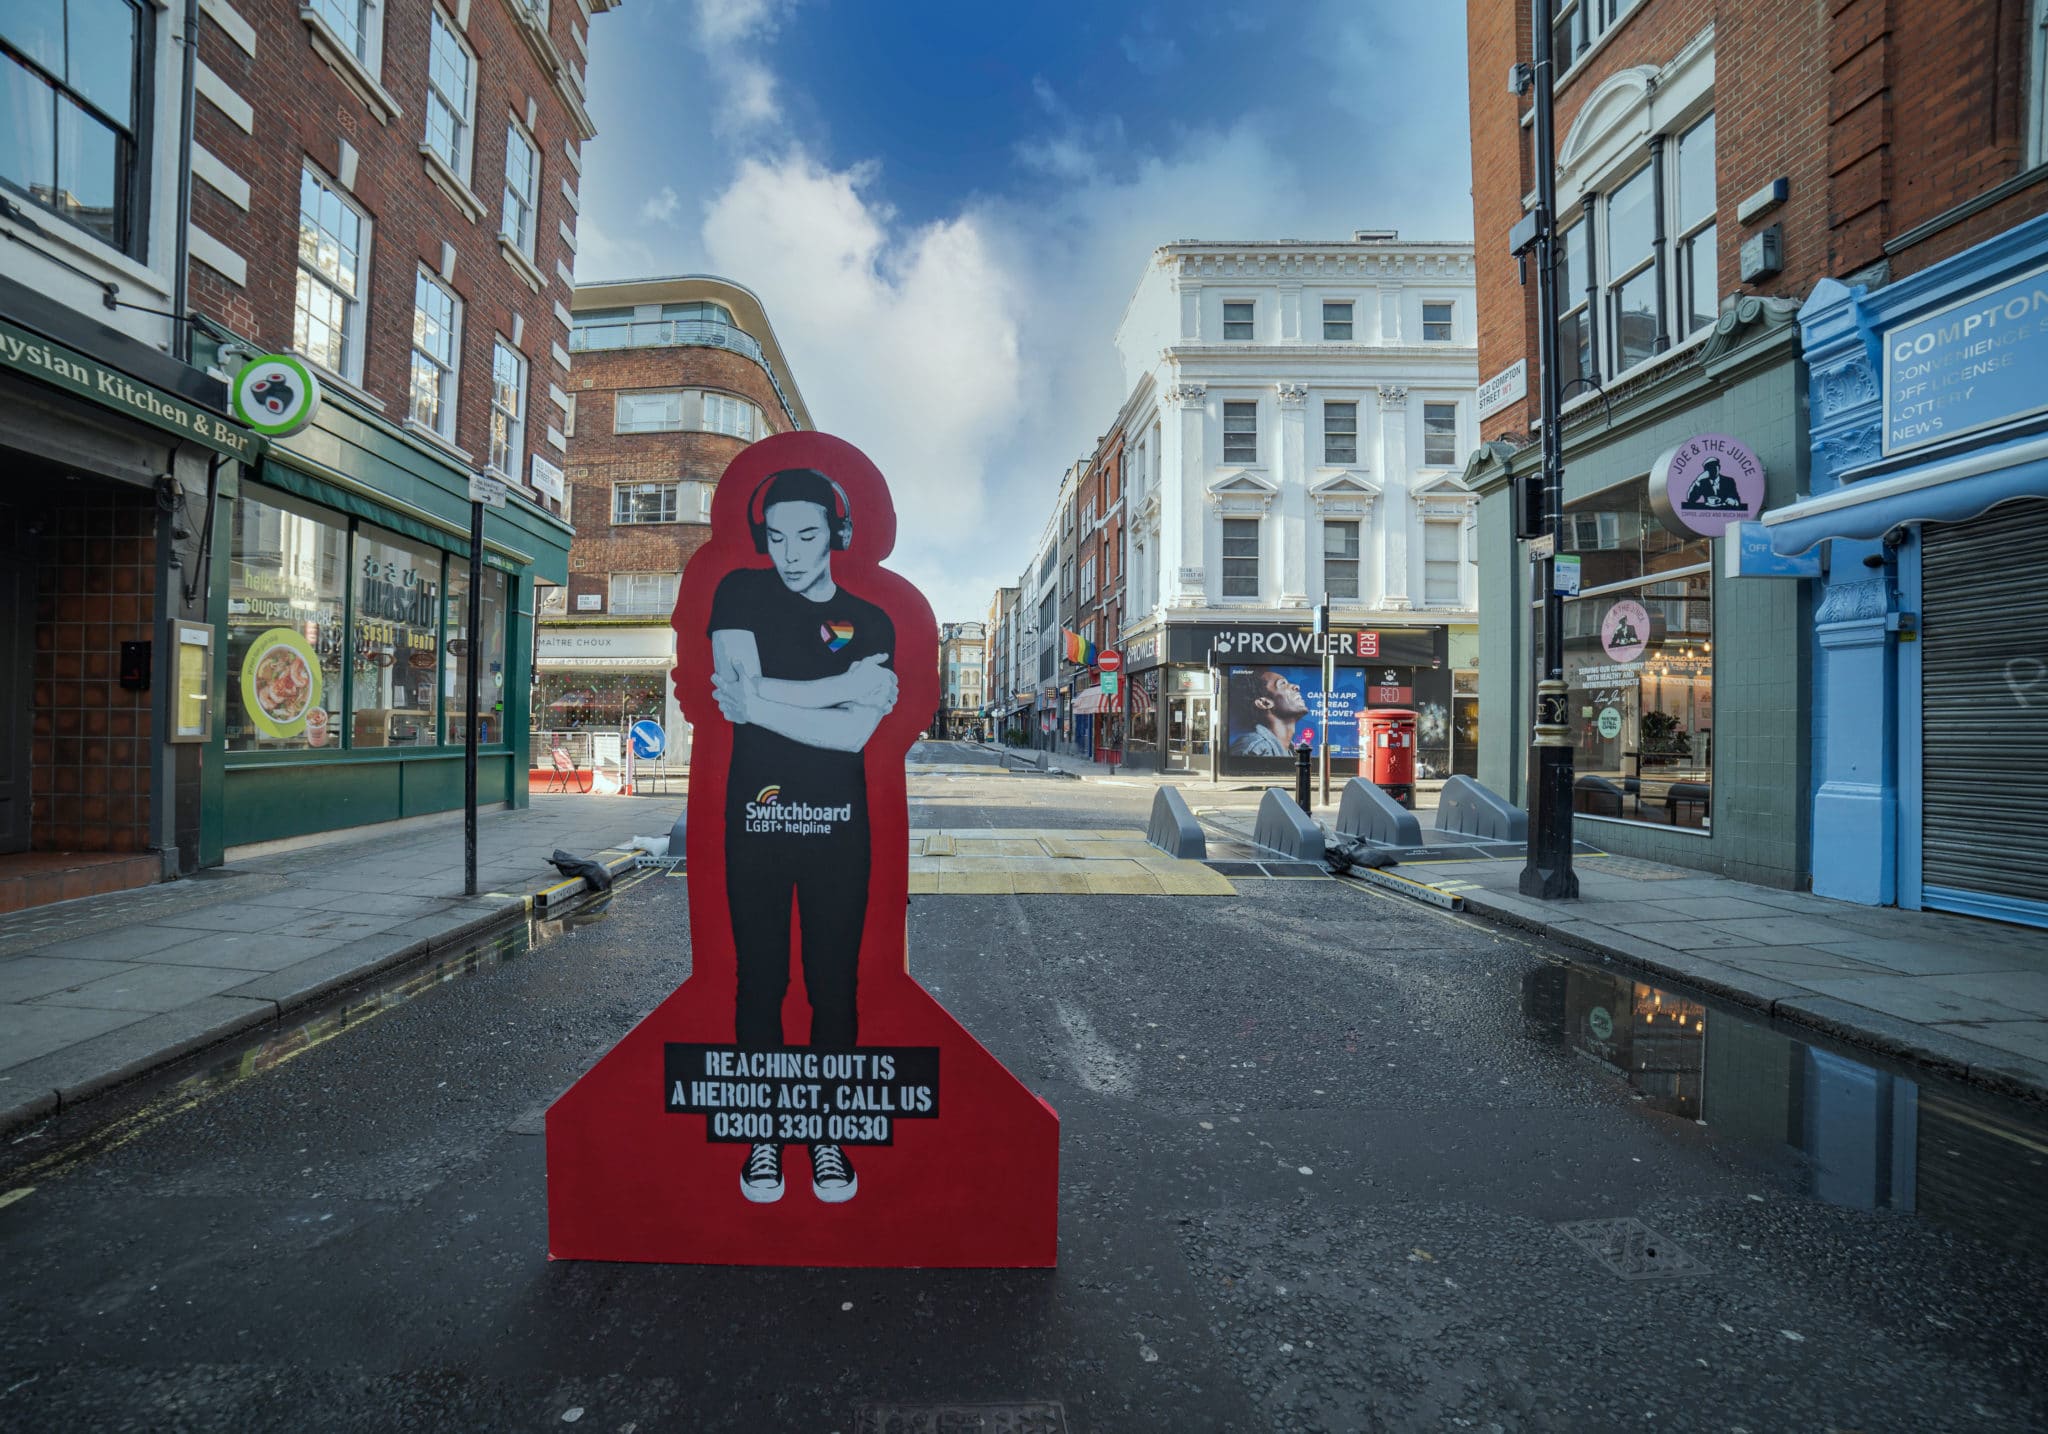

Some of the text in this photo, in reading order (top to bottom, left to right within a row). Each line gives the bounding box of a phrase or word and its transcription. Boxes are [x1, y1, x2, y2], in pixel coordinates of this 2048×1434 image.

[1479, 365, 1521, 399] OLD COMPTON
[1895, 352, 2014, 402] OFF LICENSE
[97, 369, 188, 427] Kitchen
[193, 413, 209, 436] &
[214, 422, 249, 451] Bar
[1479, 389, 1500, 410] STREET
[1893, 386, 1975, 423] LOTTERY
[1673, 440, 1756, 477] JOE & THE JUICE
[1749, 543, 1768, 553] OFF
[244, 597, 280, 620] soups
[363, 624, 393, 645] sushi
[539, 637, 612, 647] MAÎTRE CHOUX
[1237, 632, 1354, 655] PROWLER
[1360, 633, 1376, 655] RED
[1622, 671, 1635, 679] AND
[1381, 687, 1400, 703] RED
[745, 801, 851, 822] Switchboard
[745, 820, 831, 836] LGBT+ helpline
[705, 1050, 896, 1081] REACHING OUT IS
[671, 1080, 686, 1106] A
[691, 1081, 772, 1109] HEROIC
[836, 1086, 896, 1111] CALL
[900, 1086, 933, 1112] US
[714, 1112, 888, 1141] 0300 330 0630
